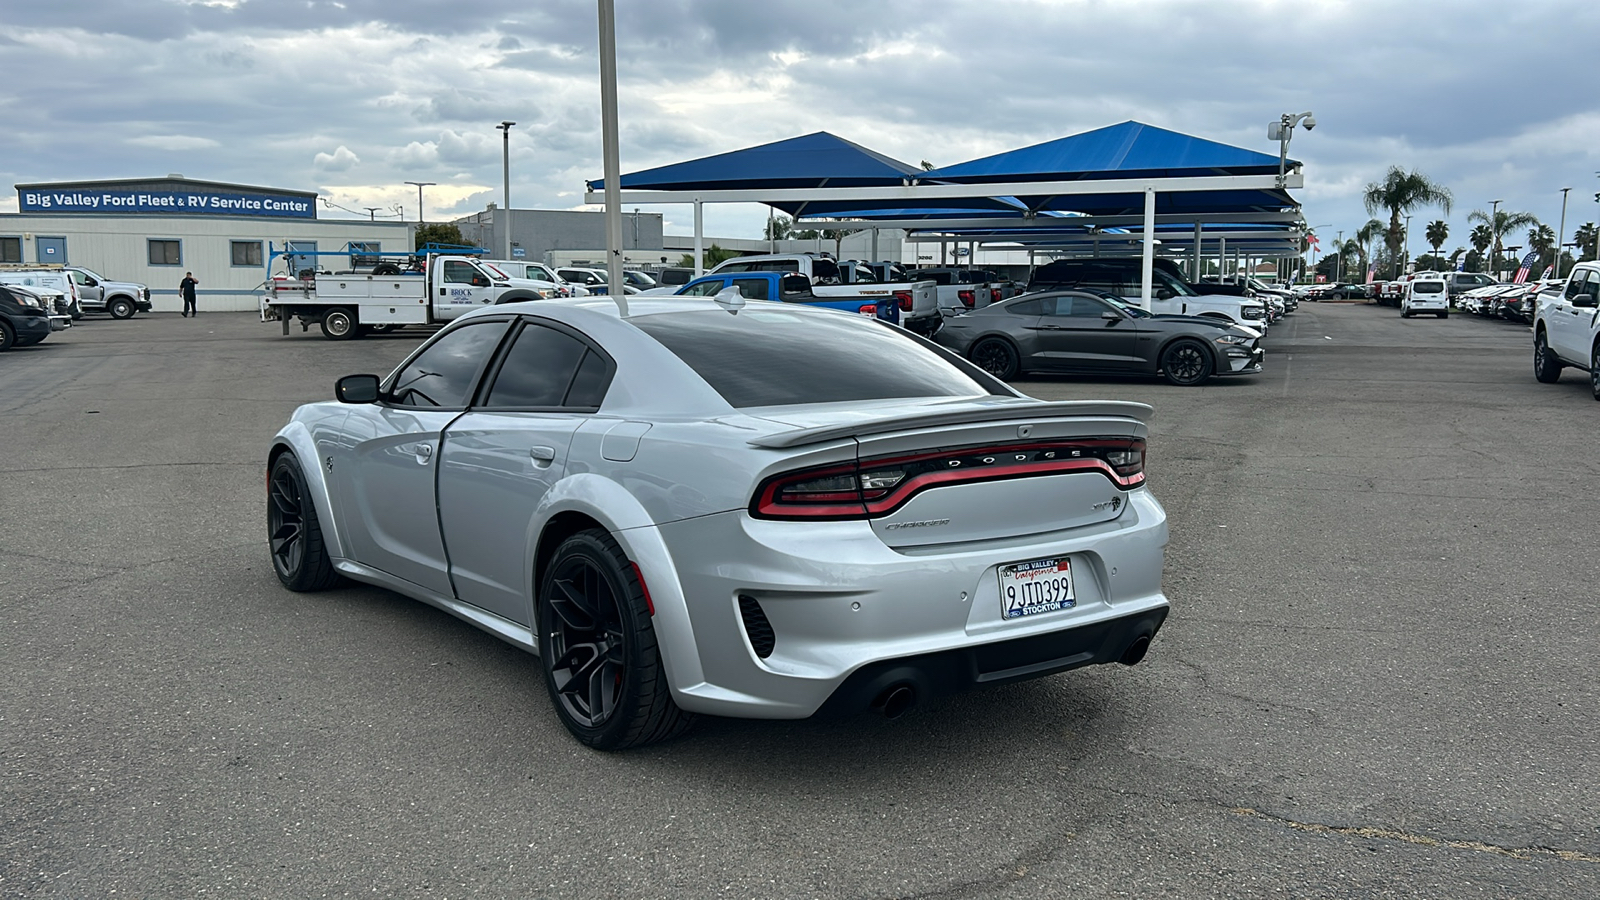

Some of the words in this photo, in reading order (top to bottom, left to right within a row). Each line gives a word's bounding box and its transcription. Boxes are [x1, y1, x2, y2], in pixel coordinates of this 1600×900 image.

[26, 194, 51, 207] Big
[54, 194, 99, 207] Valley
[102, 194, 135, 206] Ford
[138, 195, 175, 206] Fleet
[177, 199, 185, 207] &
[187, 196, 207, 207] RV
[210, 197, 260, 209] Service
[263, 199, 308, 212] Center
[949, 450, 1081, 467] DODGE
[885, 518, 950, 530] CHARGER
[1017, 563, 1030, 571] BIG
[1031, 560, 1055, 569] VALLEY
[1015, 567, 1058, 581] California
[1007, 577, 1069, 611] 9JID399
[1022, 602, 1061, 615] STOCKTON
